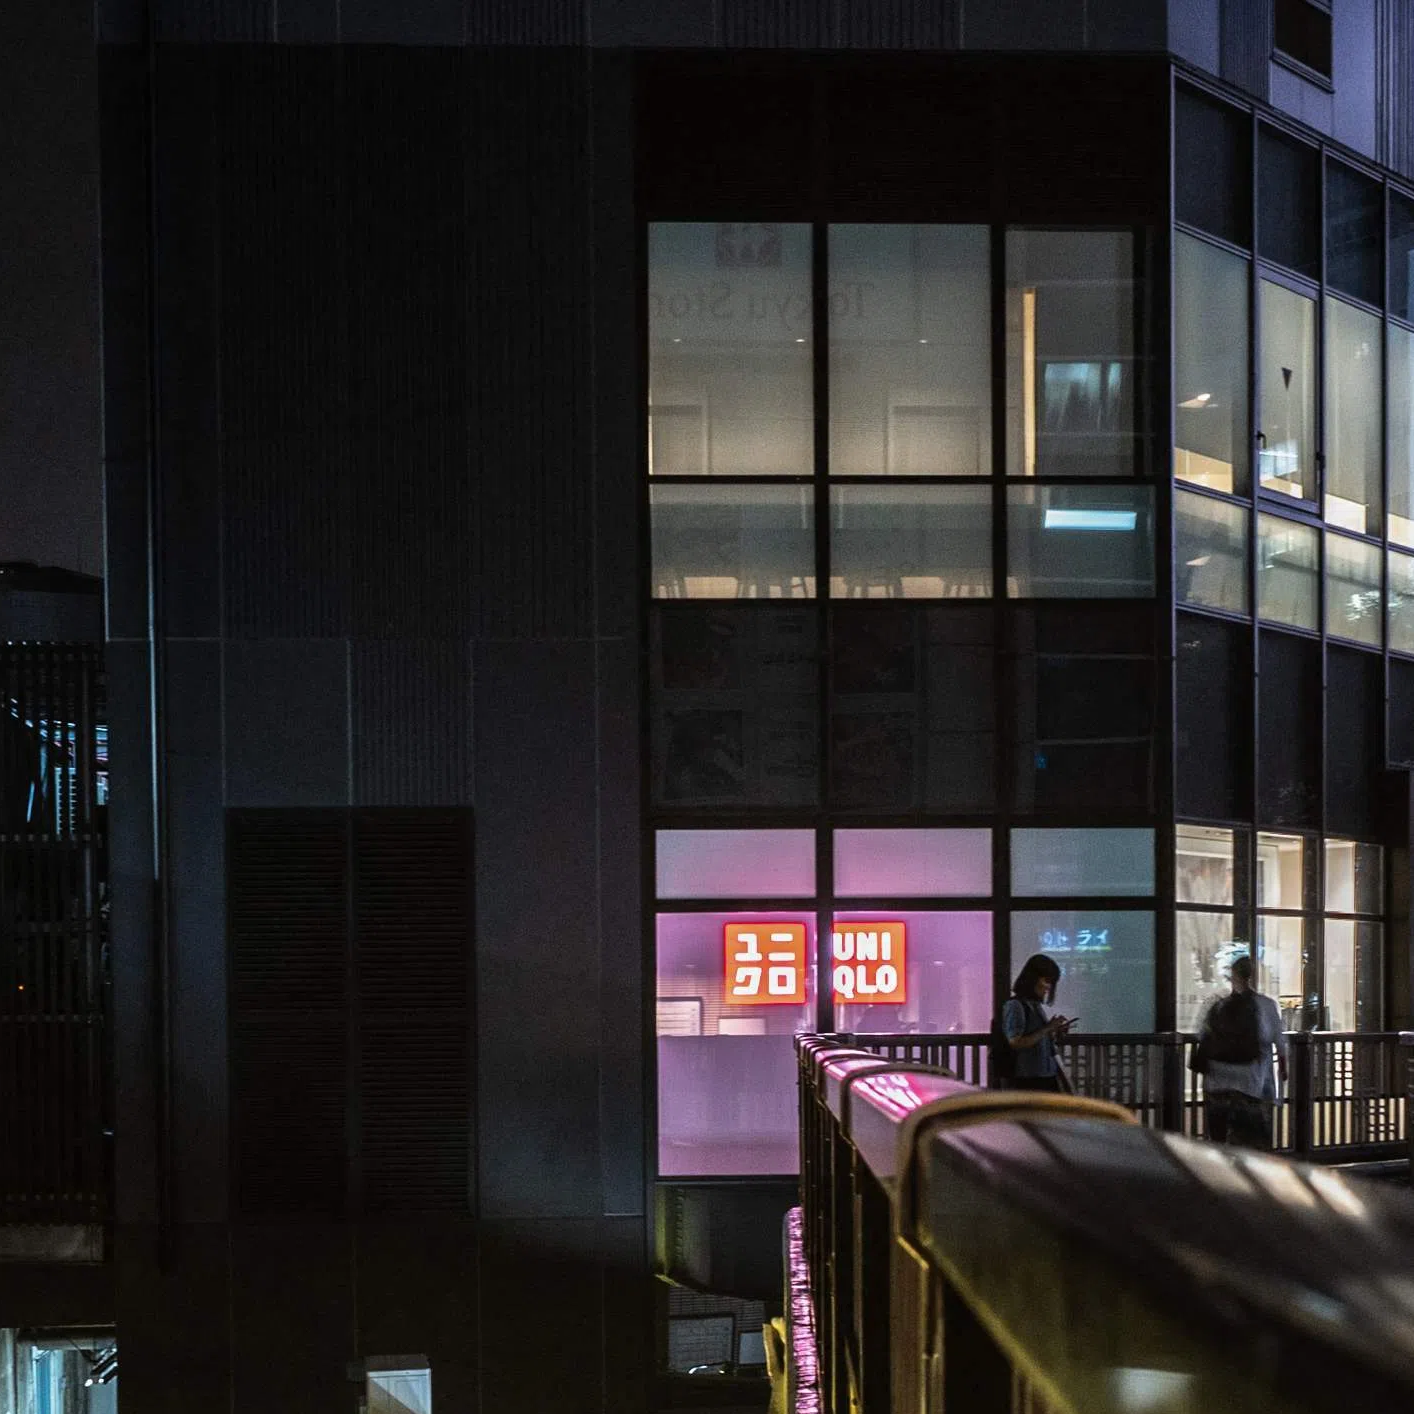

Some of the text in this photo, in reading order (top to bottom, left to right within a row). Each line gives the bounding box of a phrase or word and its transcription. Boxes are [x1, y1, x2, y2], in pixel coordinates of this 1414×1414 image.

[734, 933, 796, 962] ユニ
[832, 932, 892, 961] UNI
[732, 966, 796, 995] クロ
[832, 965, 898, 999] QLO
